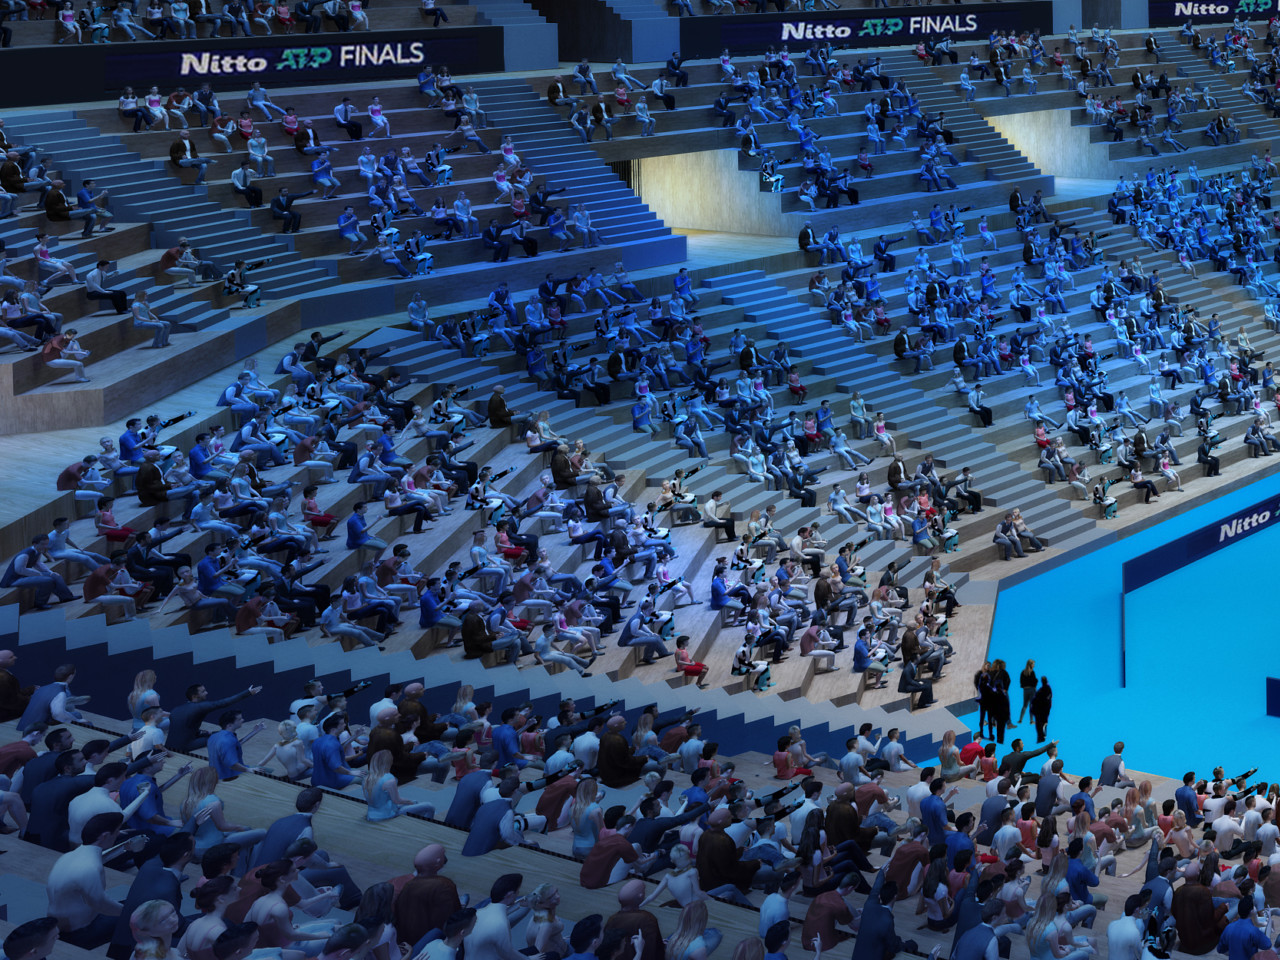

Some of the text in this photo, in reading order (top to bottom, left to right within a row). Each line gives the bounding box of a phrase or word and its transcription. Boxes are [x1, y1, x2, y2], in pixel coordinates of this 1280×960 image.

[1174, 2, 1229, 16] Nitto
[781, 14, 977, 40] Nitto ATP FINALS
[181, 42, 424, 75] Nitto ATP FINALS
[1219, 510, 1270, 542] Nitto
